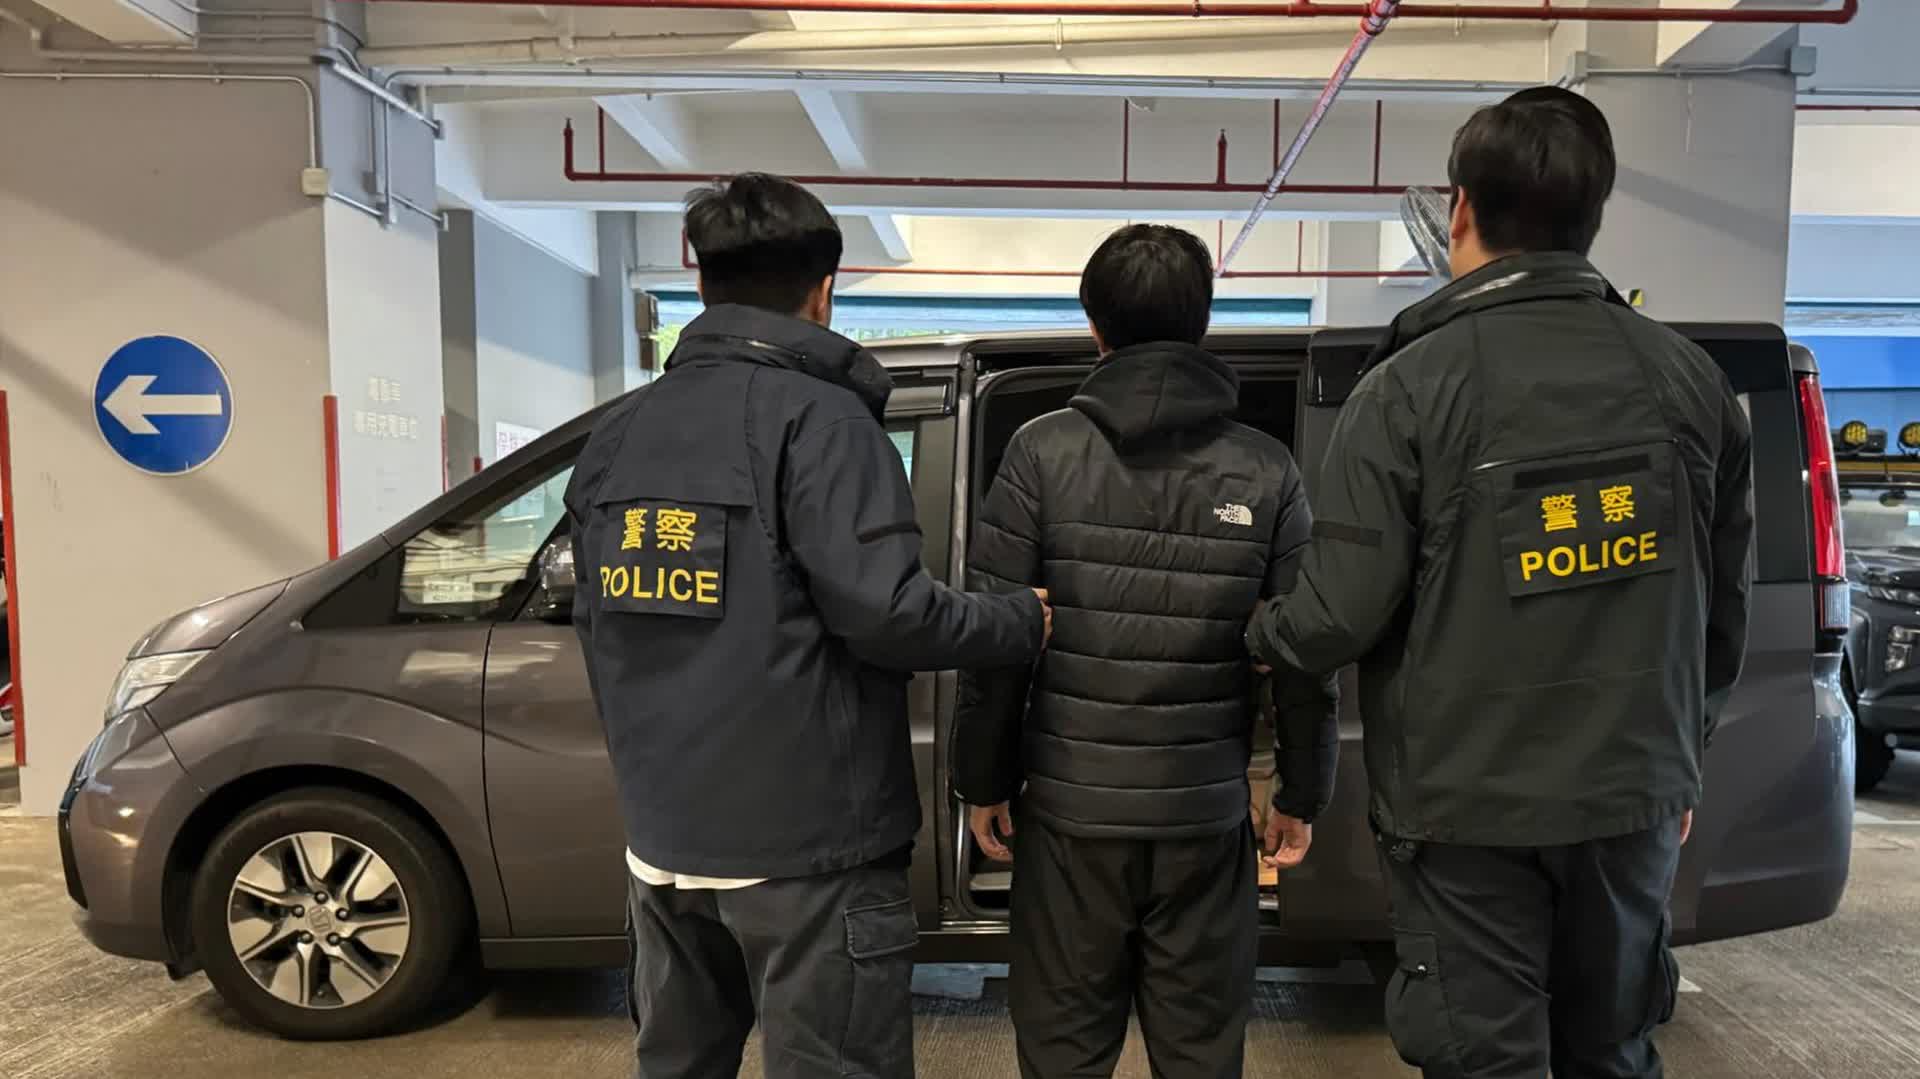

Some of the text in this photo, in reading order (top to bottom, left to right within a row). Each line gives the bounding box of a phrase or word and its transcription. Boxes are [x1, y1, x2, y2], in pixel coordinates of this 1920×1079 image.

[621, 508, 697, 551] 警察
[1540, 484, 1635, 532] 警察
[1519, 531, 1658, 581] POLICE
[600, 566, 719, 603] POLICE
